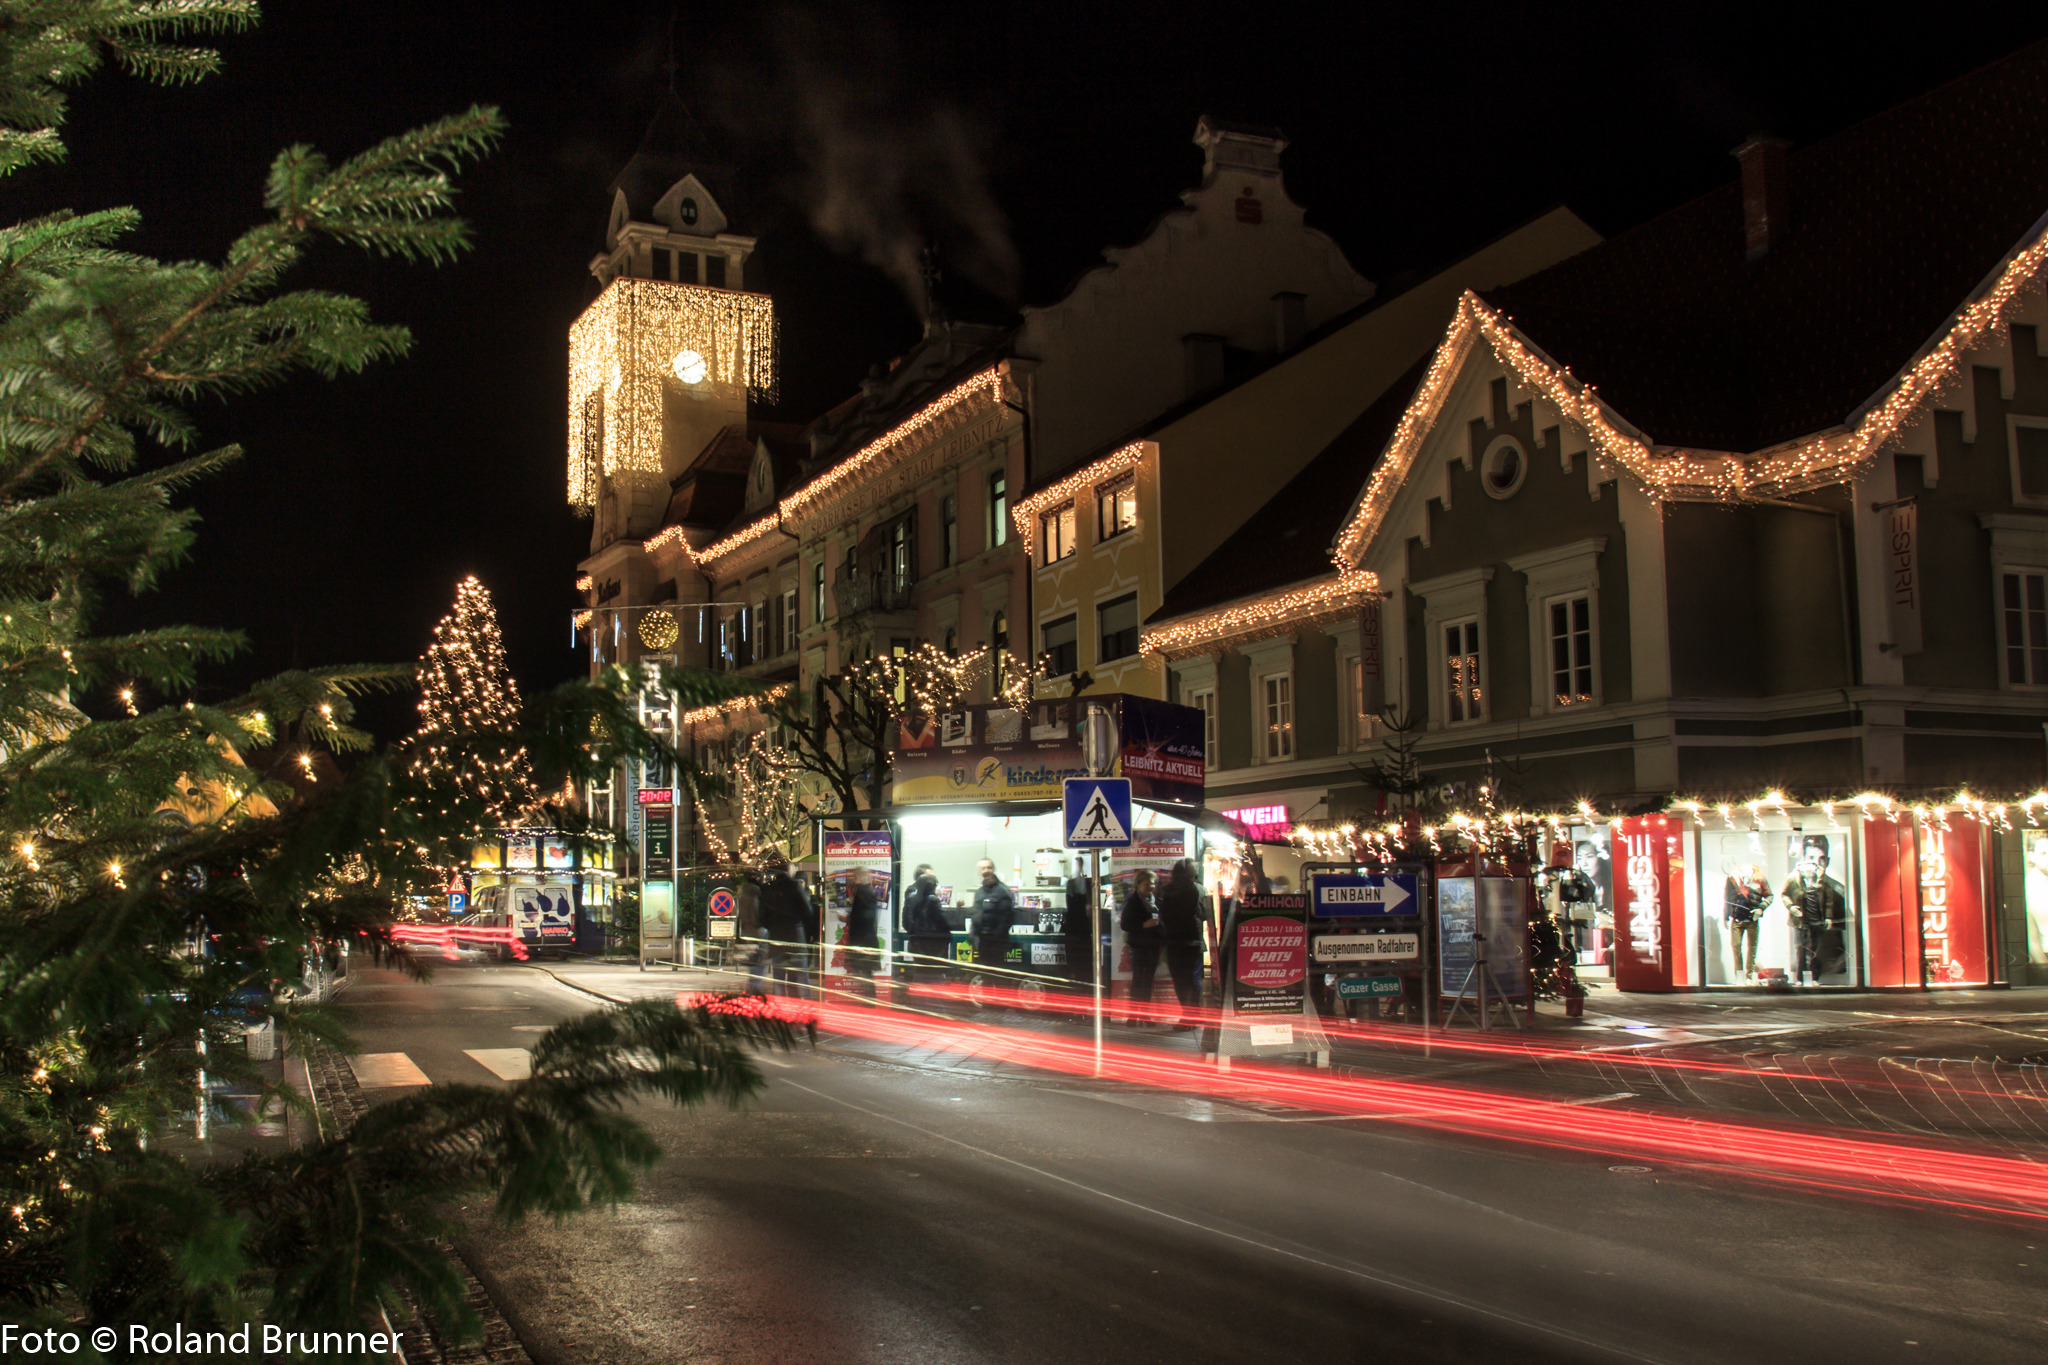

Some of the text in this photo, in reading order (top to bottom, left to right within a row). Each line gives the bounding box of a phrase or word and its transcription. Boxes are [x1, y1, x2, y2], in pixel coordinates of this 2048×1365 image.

[811, 414, 1004, 536] SPARKASSE DER STADT LEIBNITZ
[1892, 513, 1914, 610] ESPRIT
[1362, 605, 1380, 681] ESPRIT
[1124, 755, 1163, 772] LEIBNITZ
[1165, 761, 1203, 778] AKTUELL
[1327, 888, 1381, 902] EINBAHN
[1628, 834, 1655, 956] ESPRIT
[541, 926, 569, 934] MARKO
[1240, 925, 1278, 933] 31.12.2014
[1285, 925, 1304, 933] 18:00
[1240, 936, 1303, 947] SILVESTER
[1317, 938, 1416, 958] Ausgenommen Radfahrer
[1250, 951, 1293, 962] PARTY
[1340, 981, 1400, 994] Grazer Gasse
